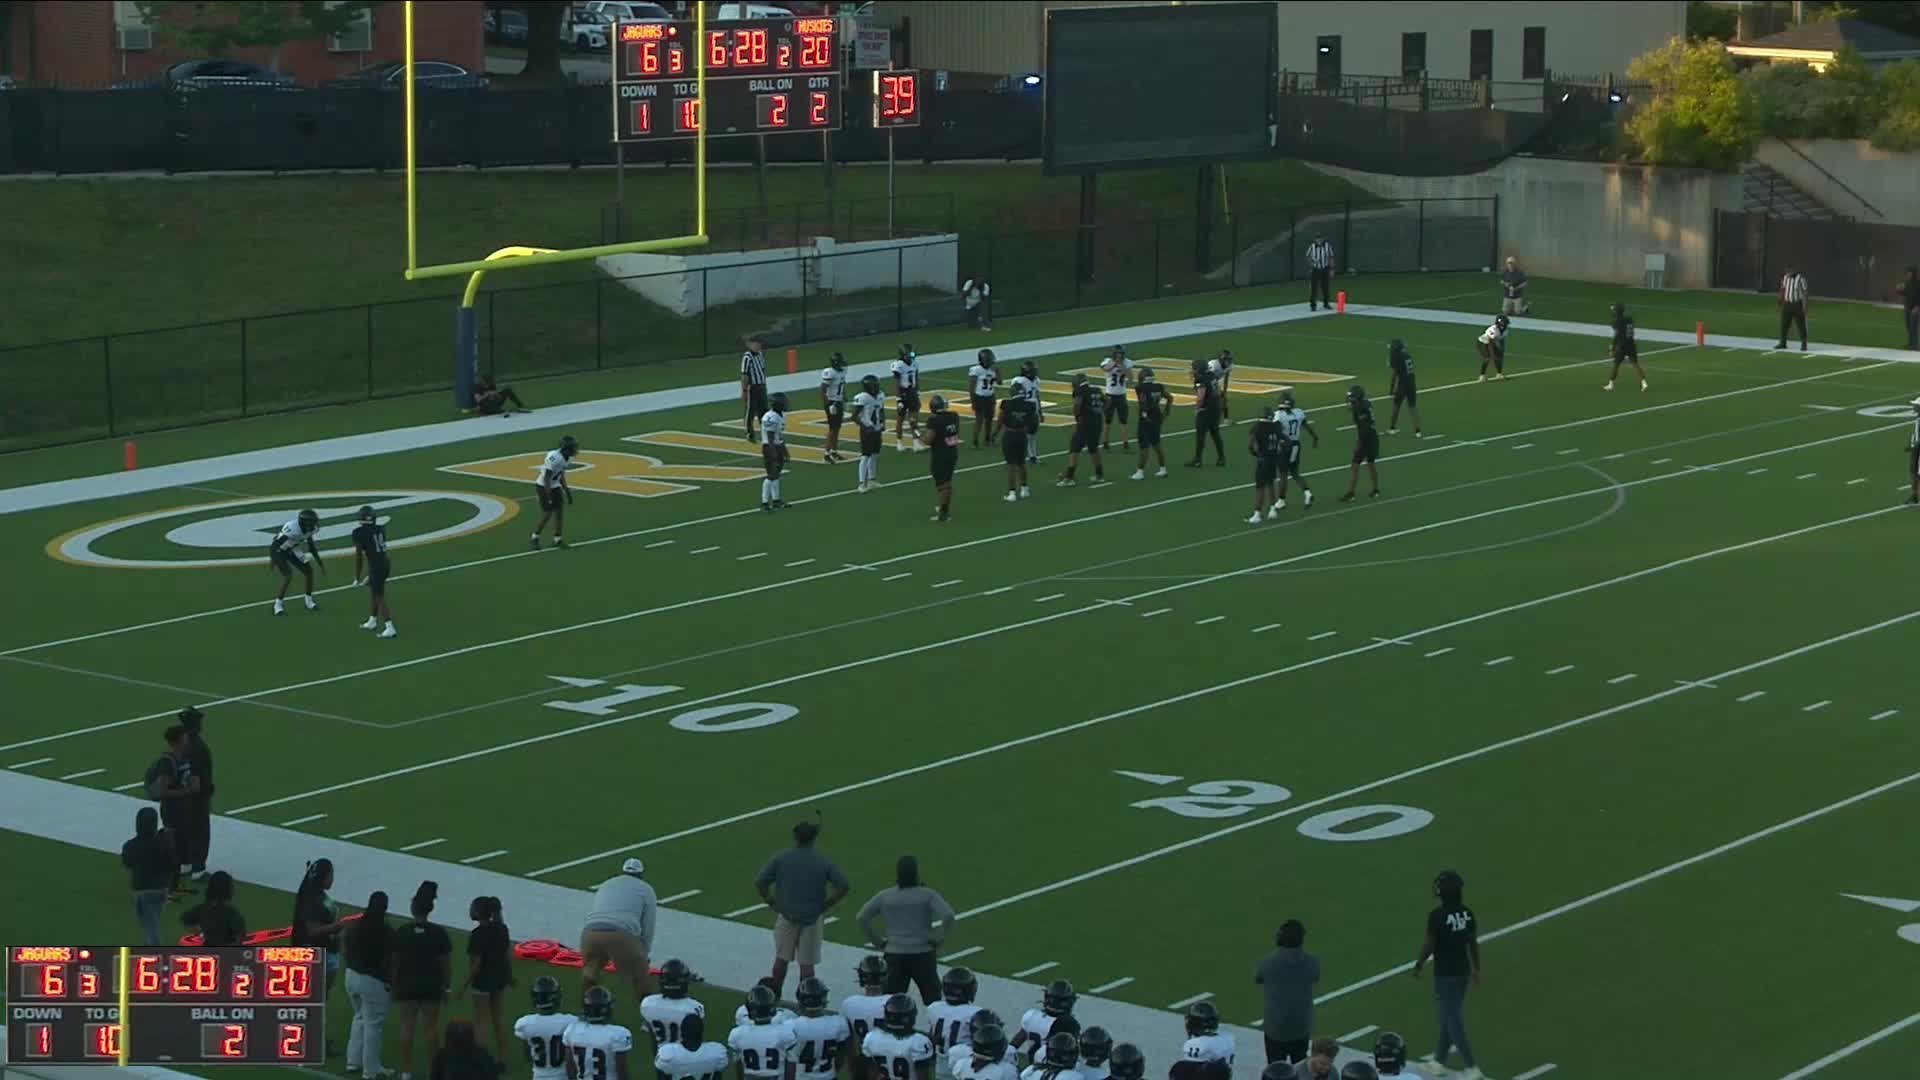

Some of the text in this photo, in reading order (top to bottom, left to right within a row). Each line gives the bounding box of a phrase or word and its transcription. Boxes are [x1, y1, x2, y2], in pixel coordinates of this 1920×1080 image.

[622, 24, 663, 40] JAGUARS
[798, 19, 833, 33] HUSKIES
[642, 43, 658, 73] 6
[671, 50, 682, 72] 3
[711, 29, 767, 66] 6:28
[780, 46, 790, 67] 2
[802, 37, 830, 66] 20
[621, 85, 657, 98] DOWN
[673, 83, 688, 95] TO
[750, 79, 793, 92] BALL ON
[808, 78, 830, 90] QTR
[883, 76, 915, 117] 39
[772, 95, 787, 125] 2
[812, 94, 827, 124] 2
[541, 684, 799, 733] 10
[1127, 780, 1435, 841] 20
[1446, 911, 1471, 925] ALL
[531, 1034, 566, 1068] 30
[574, 1046, 607, 1080] 73
